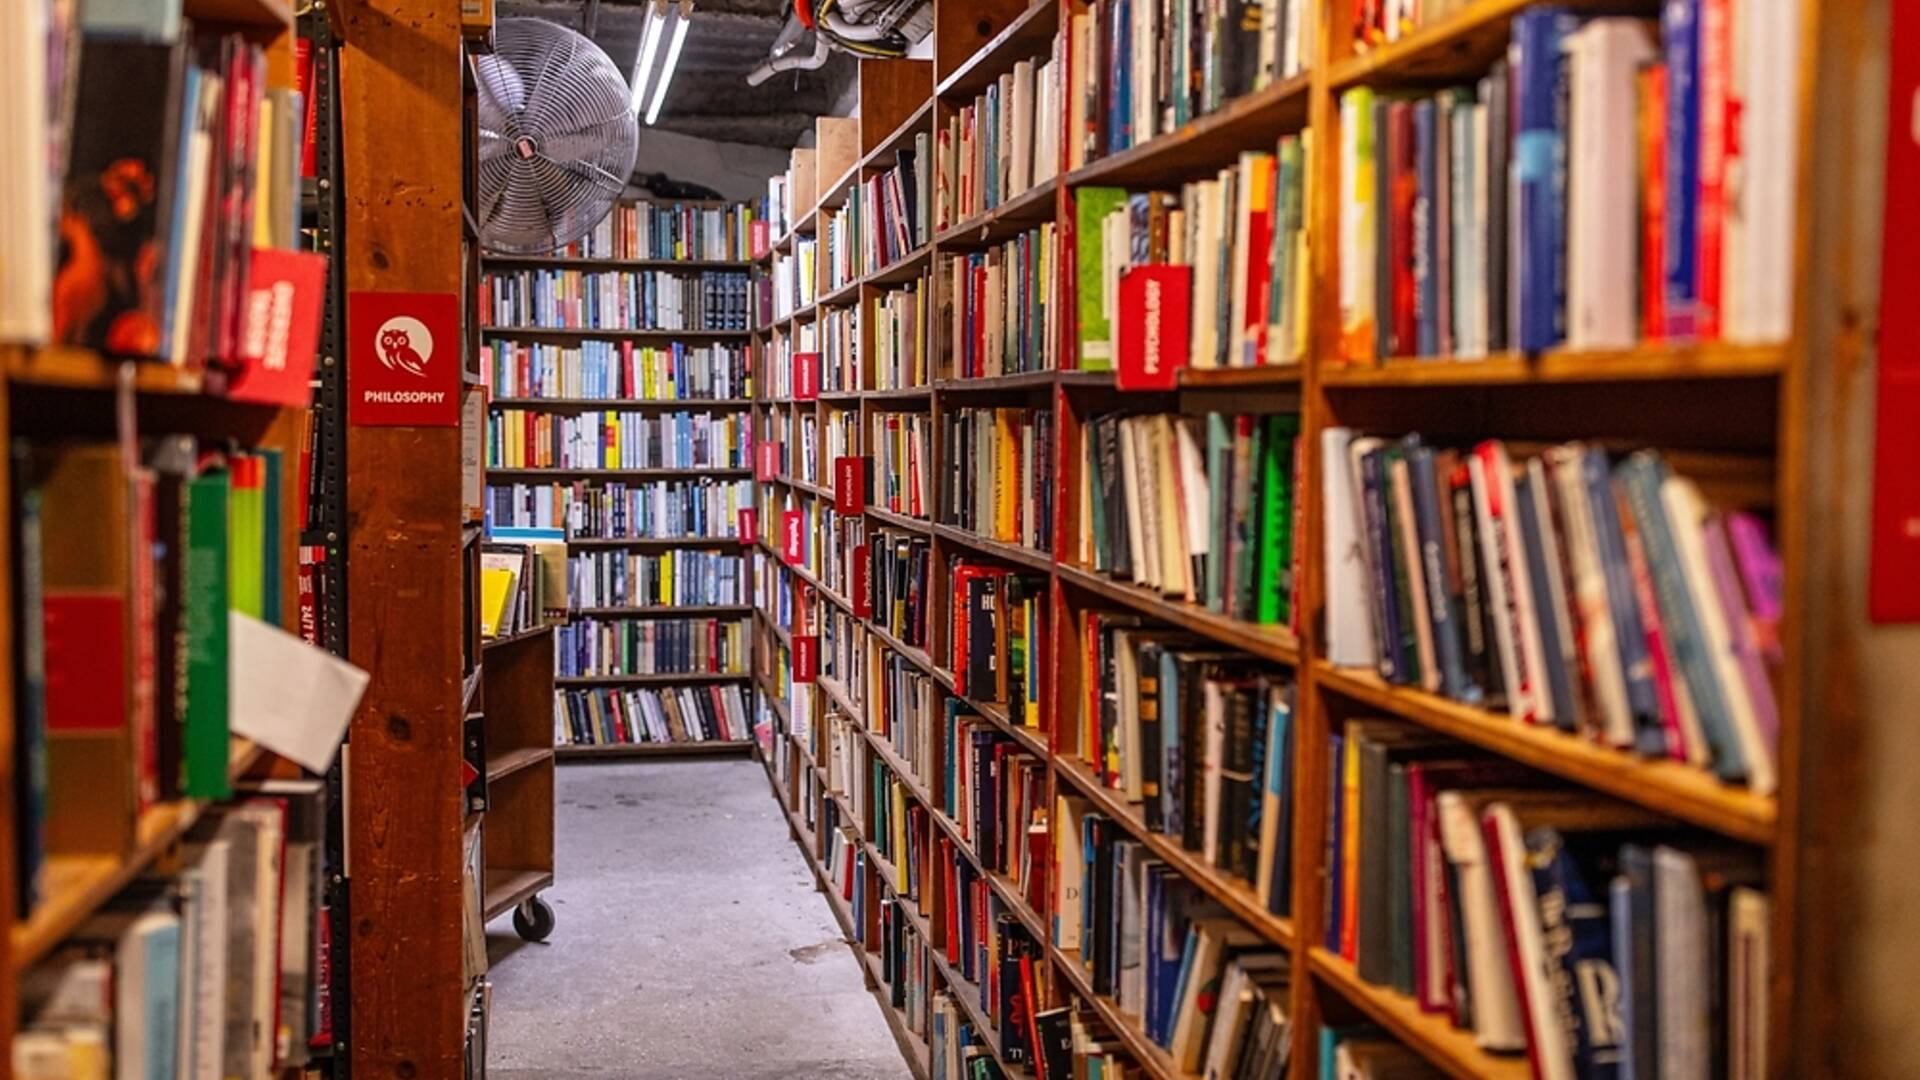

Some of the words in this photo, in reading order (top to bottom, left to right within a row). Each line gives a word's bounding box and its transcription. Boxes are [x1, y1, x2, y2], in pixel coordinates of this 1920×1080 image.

[1144, 279, 1161, 374] PSYCHOLOGY
[364, 391, 445, 403] PHILOSOPHY
[845, 465, 853, 507] PSYCHOLOGY
